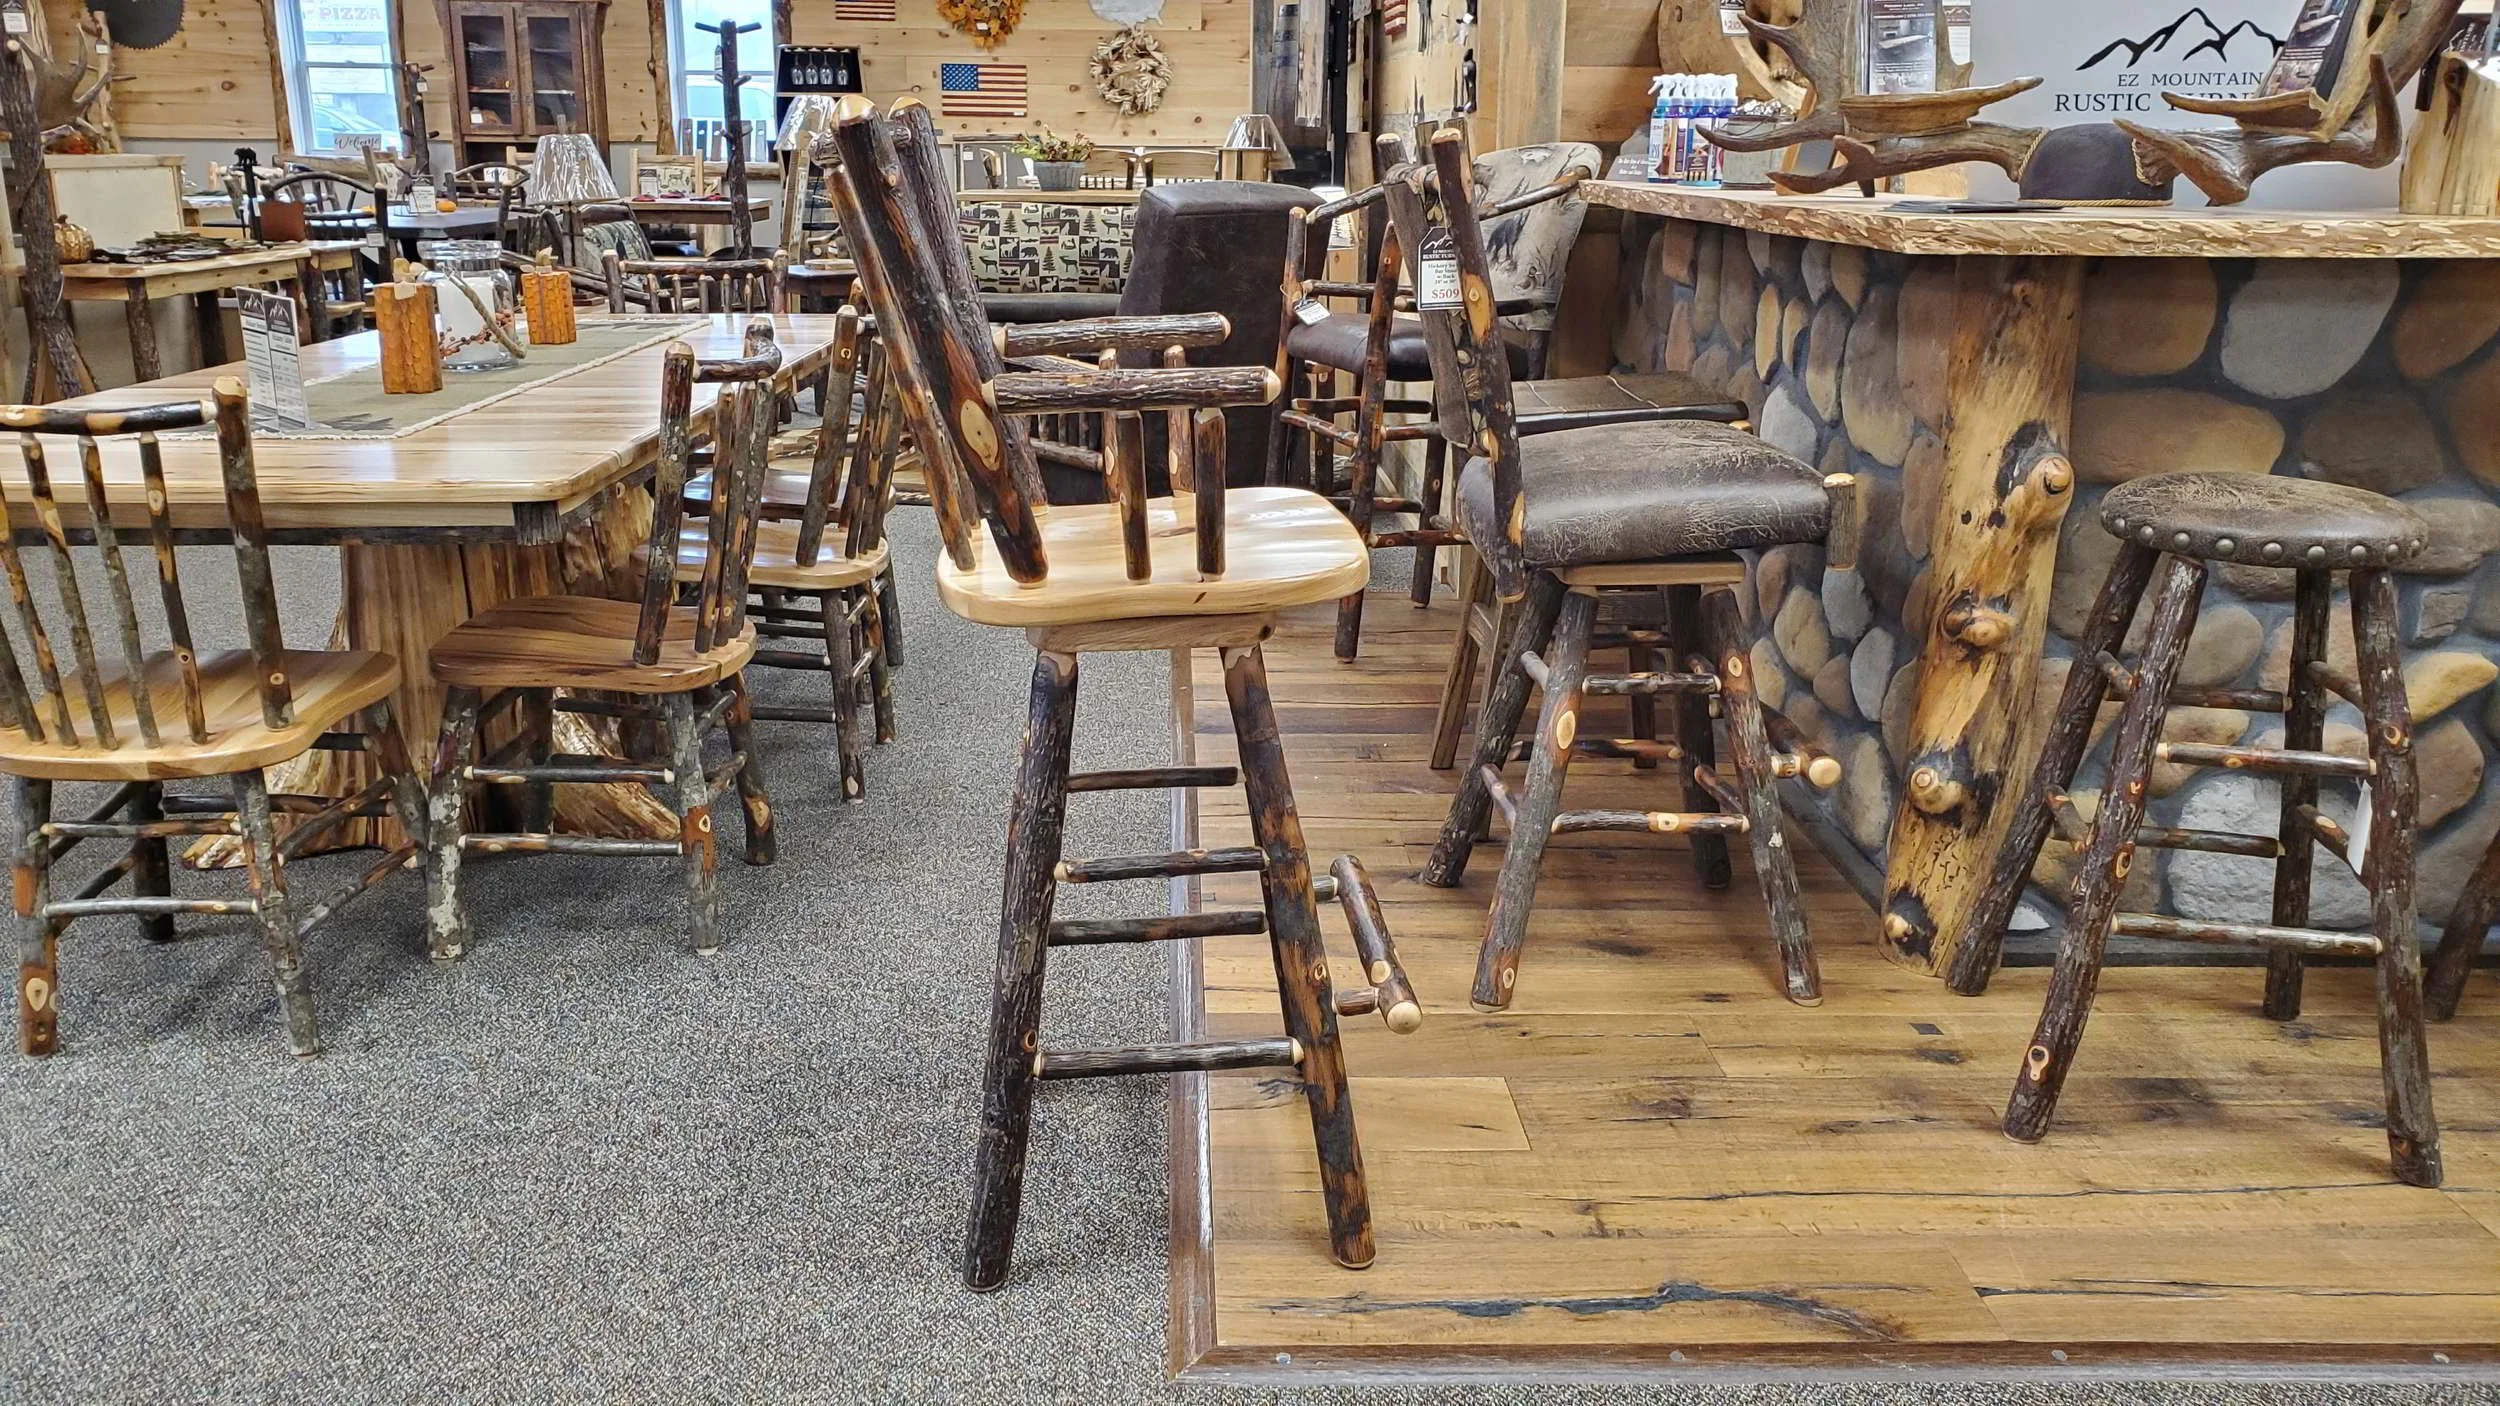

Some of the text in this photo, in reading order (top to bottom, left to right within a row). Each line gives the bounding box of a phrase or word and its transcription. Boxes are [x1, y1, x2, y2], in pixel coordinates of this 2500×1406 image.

[319, 7, 381, 20] PIZZA
[2117, 72, 2263, 87] EZ MOUNTAIN
[2055, 93, 2151, 111] RUSTIC
[334, 136, 378, 150] Welcome
[1431, 288, 1460, 299] $509
